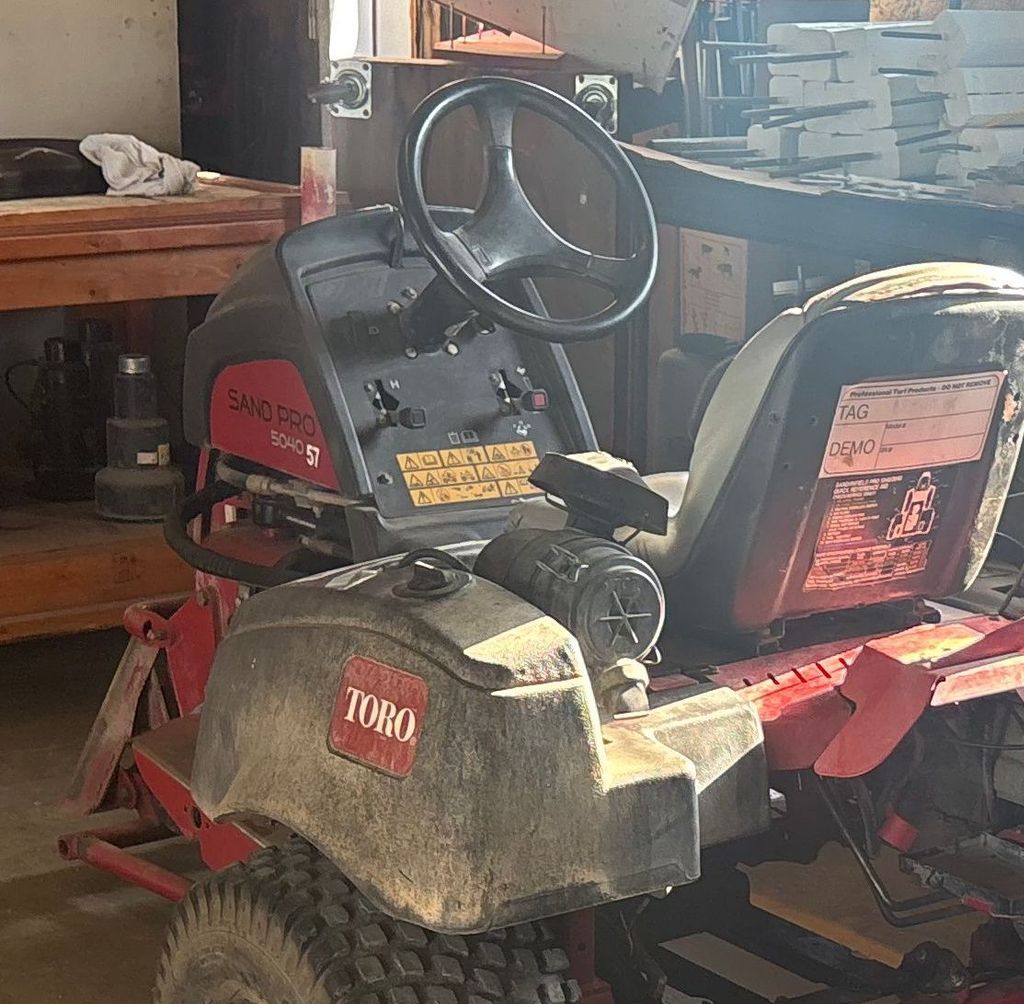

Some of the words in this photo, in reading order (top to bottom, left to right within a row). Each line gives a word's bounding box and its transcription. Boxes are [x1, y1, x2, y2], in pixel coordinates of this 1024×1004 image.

[893, 387, 908, 396] Turf
[908, 385, 937, 394] Products
[941, 383, 951, 391] DO
[952, 382, 965, 390] NOT
[965, 379, 992, 388] REMOVE
[228, 388, 272, 422] SAND
[277, 404, 315, 437] PRO
[839, 403, 870, 421] TAG
[270, 429, 304, 455] 5040
[828, 438, 876, 457] DEMO
[306, 443, 320, 469] 57
[344, 686, 416, 743] TORO
